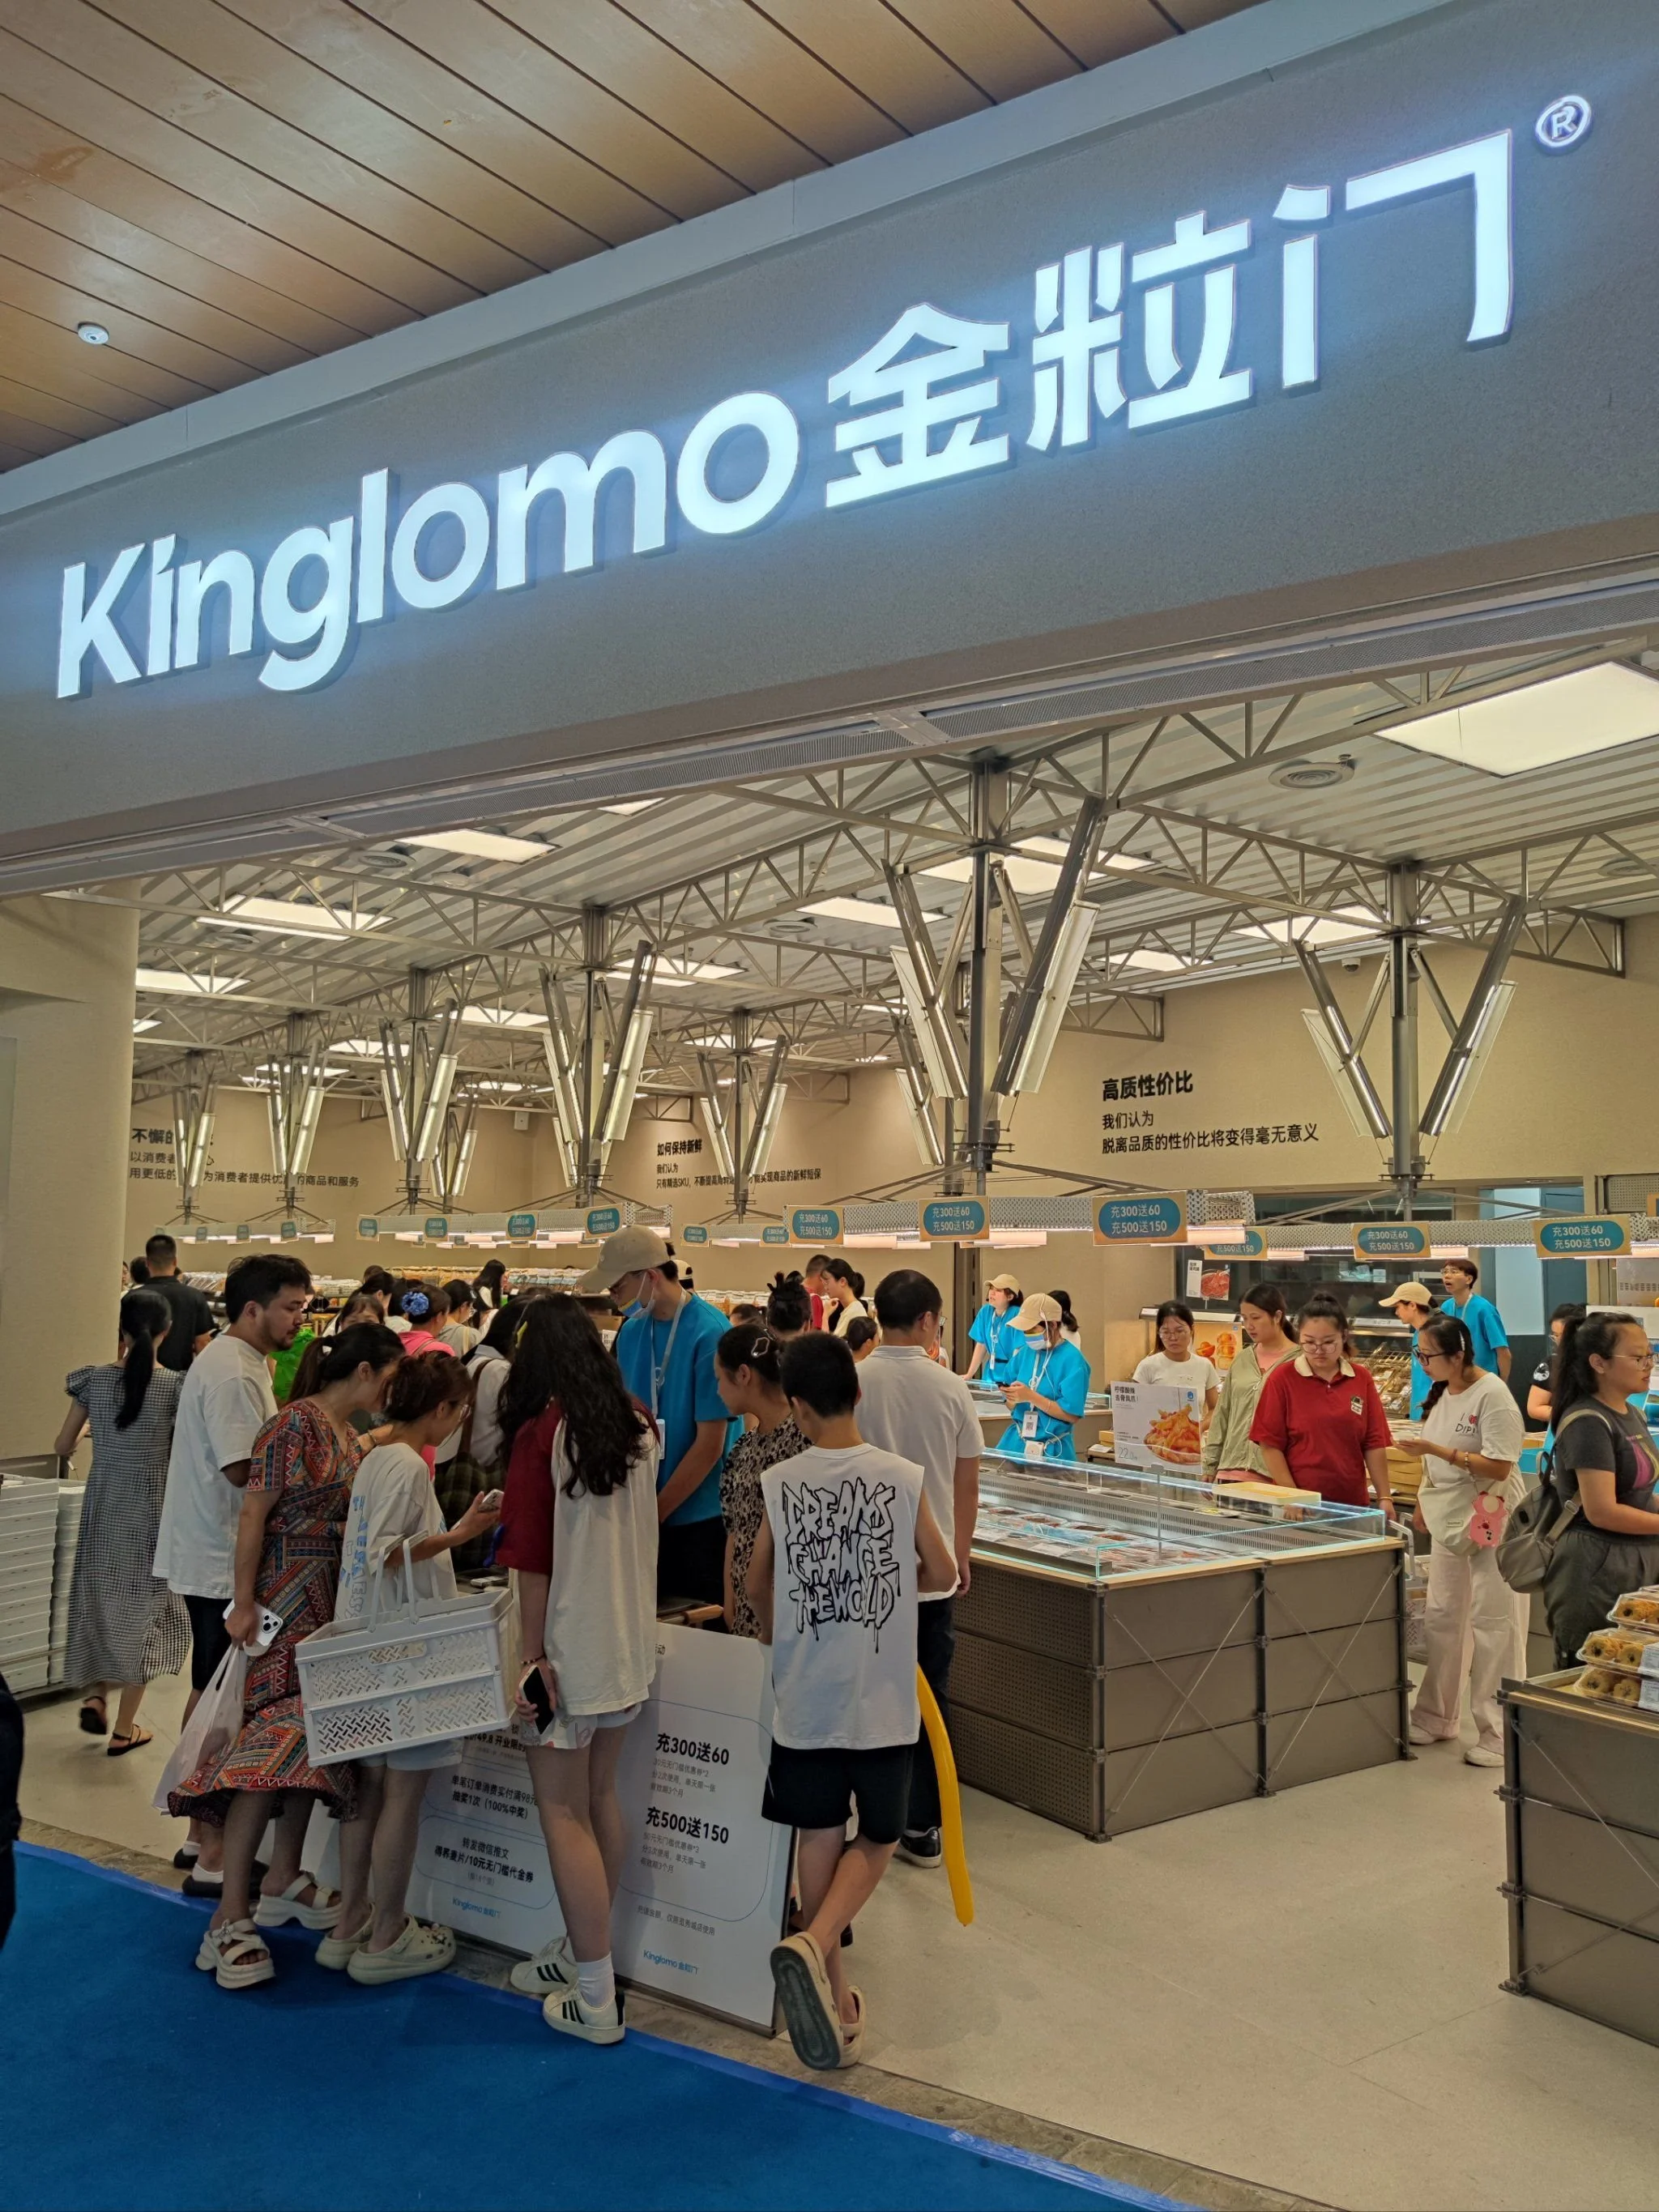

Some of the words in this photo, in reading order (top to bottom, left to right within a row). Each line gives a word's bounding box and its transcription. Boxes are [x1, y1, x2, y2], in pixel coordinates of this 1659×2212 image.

[57, 390, 800, 699] Kinglomo
[825, 129, 1513, 507] 金粒门
[1102, 1071, 1193, 1102] 高质性价比
[1102, 1110, 1154, 1130] 我们认为
[1102, 1123, 1319, 1154] 脱离品质的性价比将变得毫无意义
[657, 1139, 702, 1157] 如何保持新鲜
[800, 1213, 829, 1224] 充300送60
[932, 1207, 970, 1218] 充300送60
[1111, 1204, 1161, 1219] 充300送60
[800, 1225, 833, 1236] 充500送150
[933, 1221, 975, 1232] 充500送150
[1111, 1221, 1167, 1234] 充500送150
[1552, 1225, 1603, 1238] 充300送60
[1367, 1230, 1408, 1240] 充300送60
[1216, 1244, 1254, 1253] 充500送150
[1369, 1242, 1414, 1251] 充500送150
[1555, 1238, 1611, 1250] 充500送150
[655, 1733, 730, 1766] 充300送60
[646, 1806, 729, 1843] 充500送150
[463, 1836, 510, 1860] 转发微信推文
[452, 1897, 484, 1912] Kinglomo
[643, 1949, 678, 1968] Kinglomo
